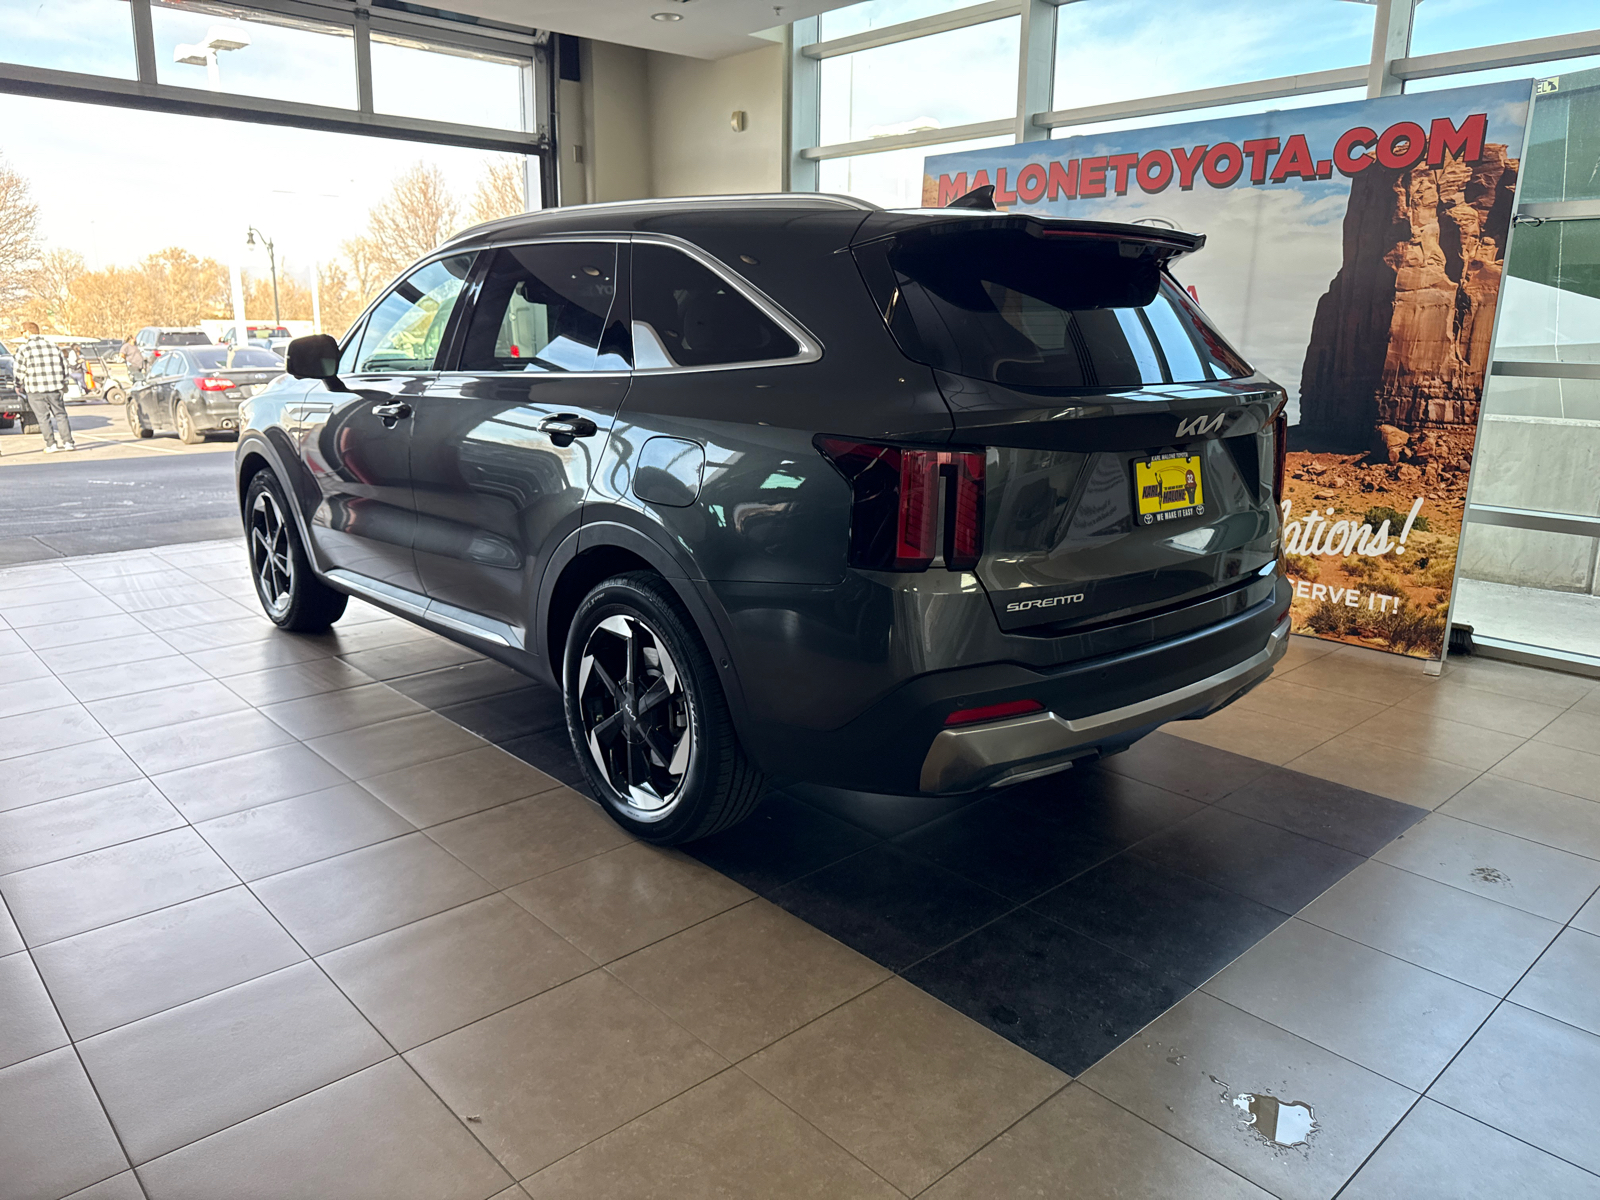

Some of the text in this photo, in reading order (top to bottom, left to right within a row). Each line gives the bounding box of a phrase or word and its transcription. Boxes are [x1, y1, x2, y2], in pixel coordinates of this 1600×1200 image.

[1175, 413, 1226, 438] KIA
[1187, 474, 1194, 483] 32
[1142, 485, 1159, 499] KARL
[1163, 488, 1186, 504] MALONE
[1156, 508, 1193, 521] WE MAKE IT EASY
[1006, 593, 1084, 612] SORENTO
[1287, 578, 1400, 615] ERVE IT!
